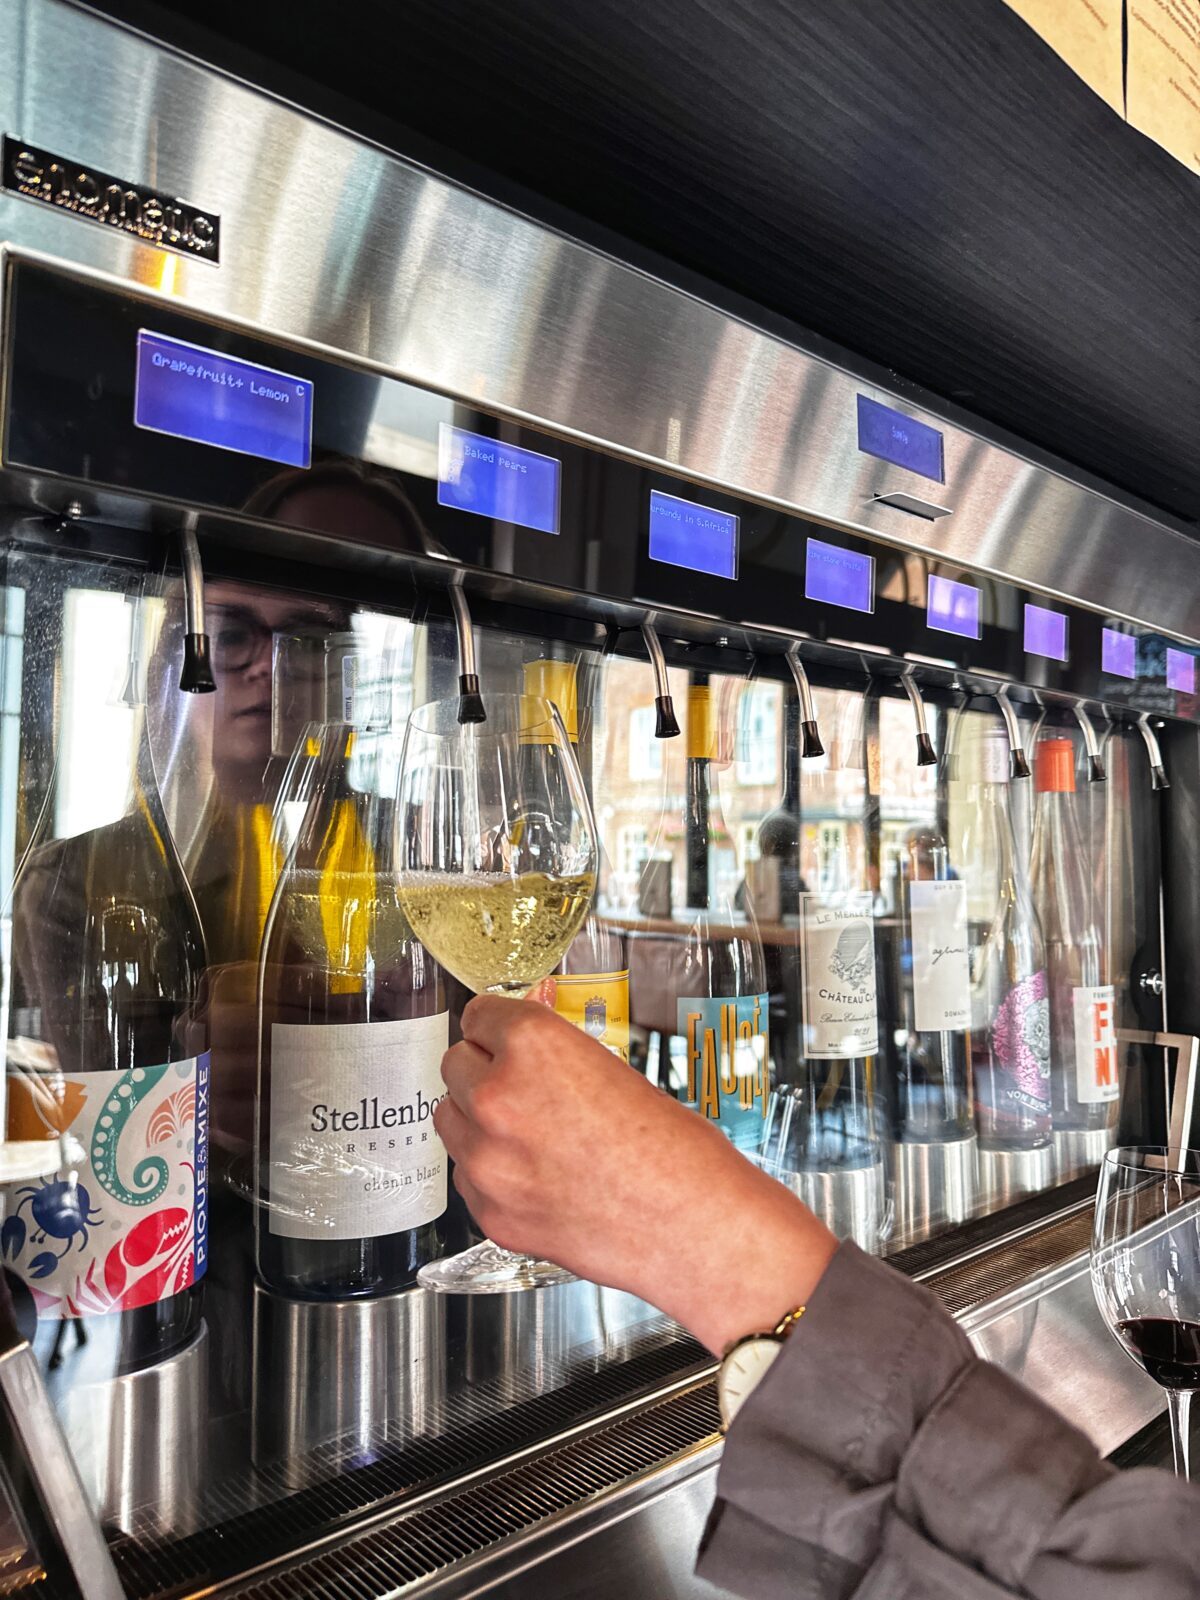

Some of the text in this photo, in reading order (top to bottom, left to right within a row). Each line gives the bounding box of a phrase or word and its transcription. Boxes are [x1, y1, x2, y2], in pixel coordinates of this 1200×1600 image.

[250, 381, 289, 403] Lemon
[464, 445, 494, 463] Baked
[685, 514, 694, 524] in
[816, 914, 832, 925] LE
[819, 988, 864, 1004] CHÂTEAU
[198, 1068, 209, 1145] MIXE
[347, 1130, 438, 1153] RESER
[364, 1165, 441, 1192] chenin blanc
[197, 1165, 207, 1265] PIQUE
